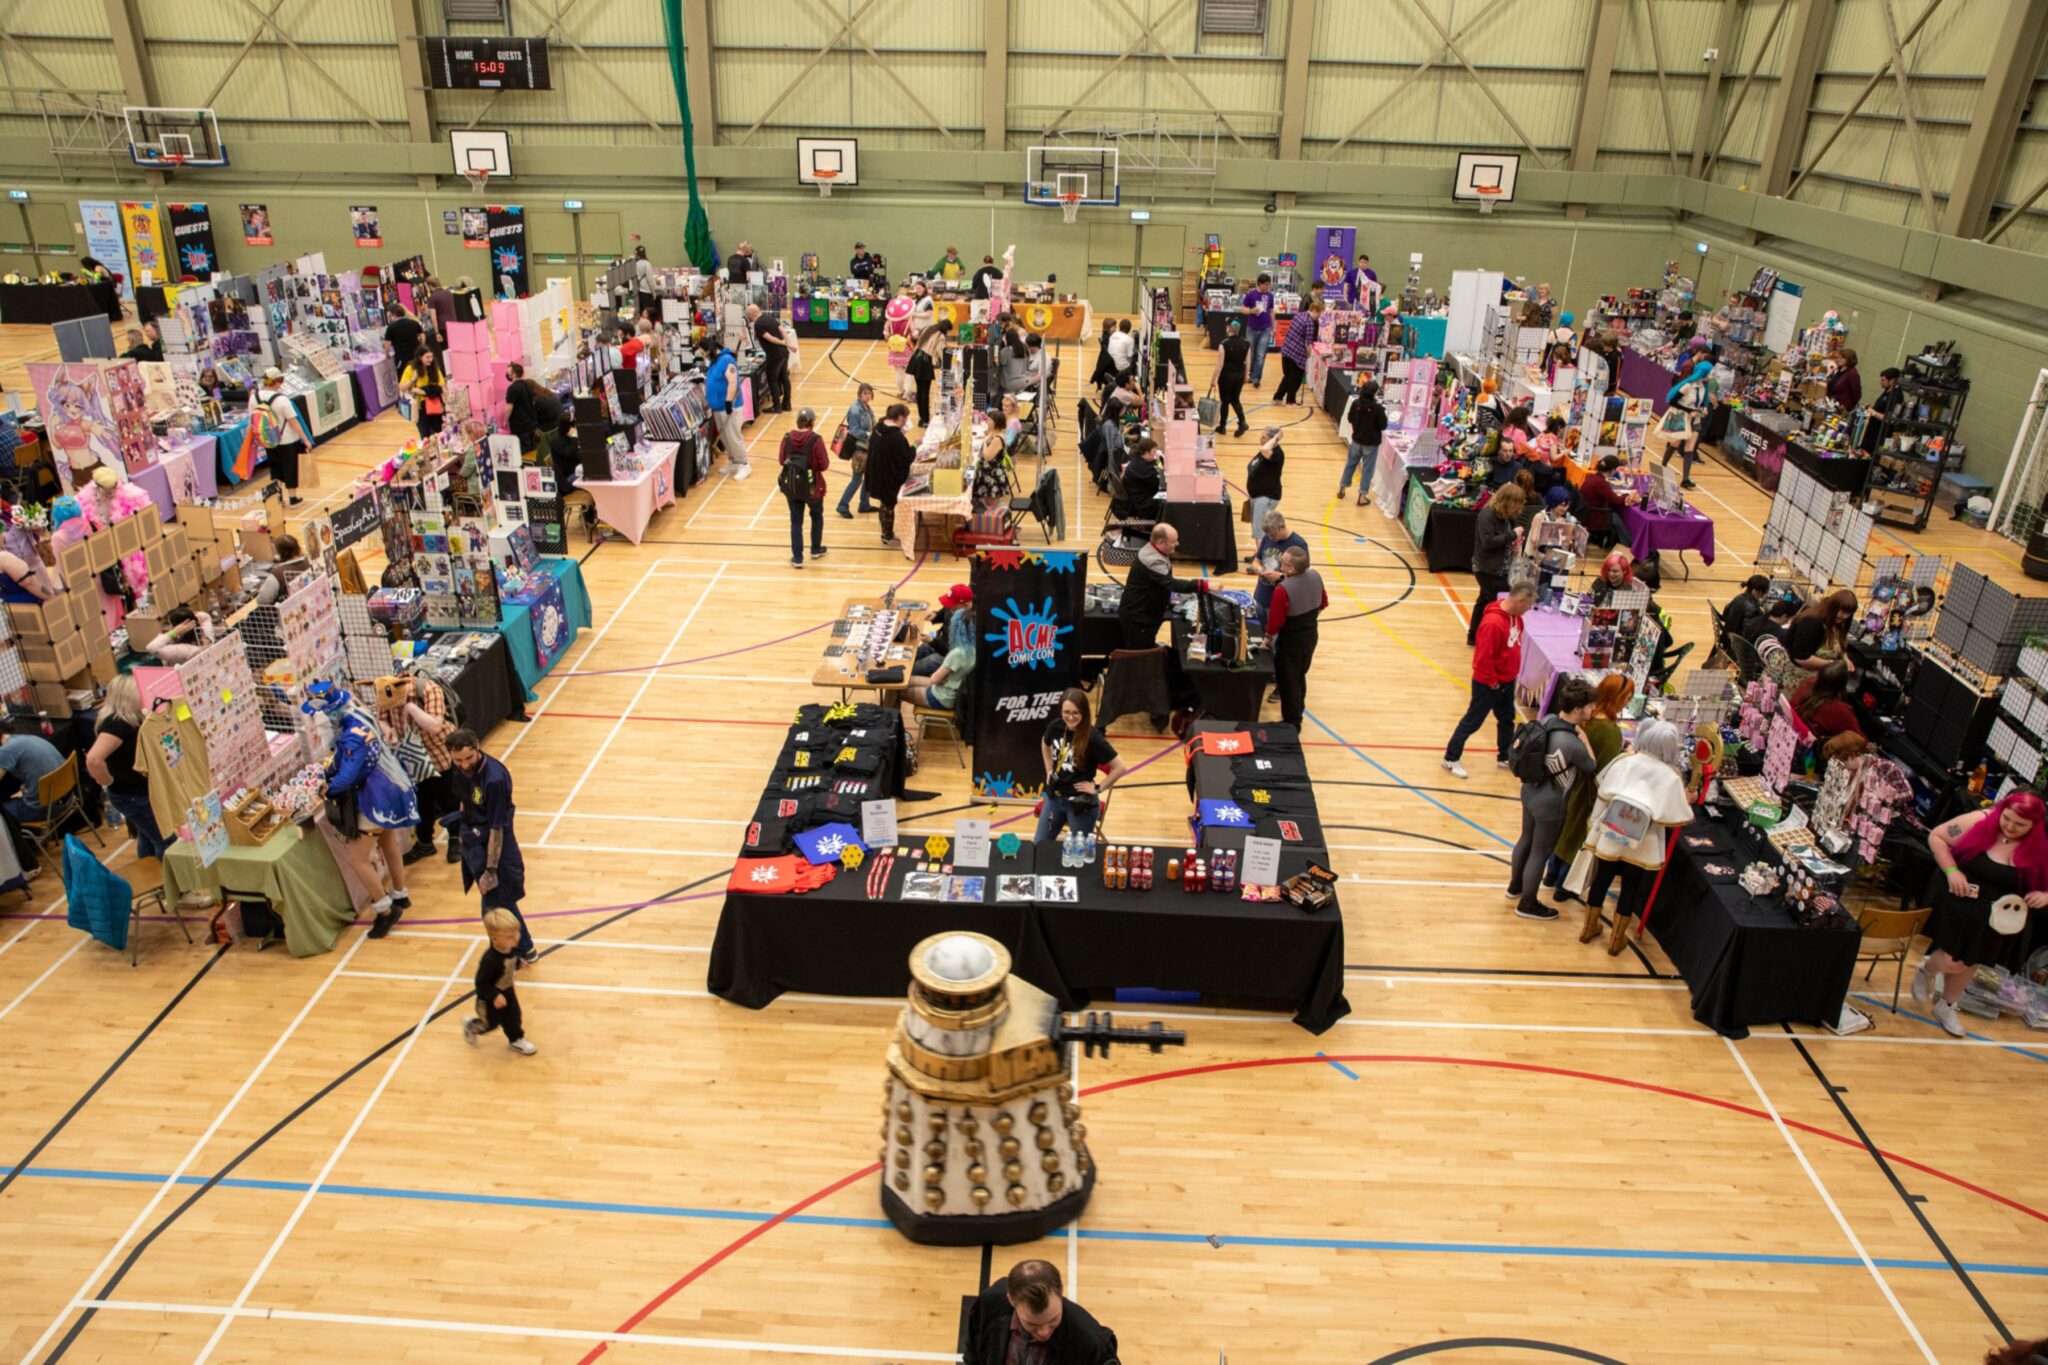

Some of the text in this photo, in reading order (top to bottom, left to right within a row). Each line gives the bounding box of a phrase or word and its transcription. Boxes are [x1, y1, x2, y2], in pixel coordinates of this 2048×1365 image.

[455, 51, 522, 60] HOME GUESTS
[174, 222, 209, 236] GUESTS
[489, 223, 523, 238] GUESTS
[1008, 618, 1058, 654] ACME
[1008, 649, 1055, 665] COMIC CON
[995, 691, 1064, 711] FOR THE
[1006, 706, 1050, 722] FANS
